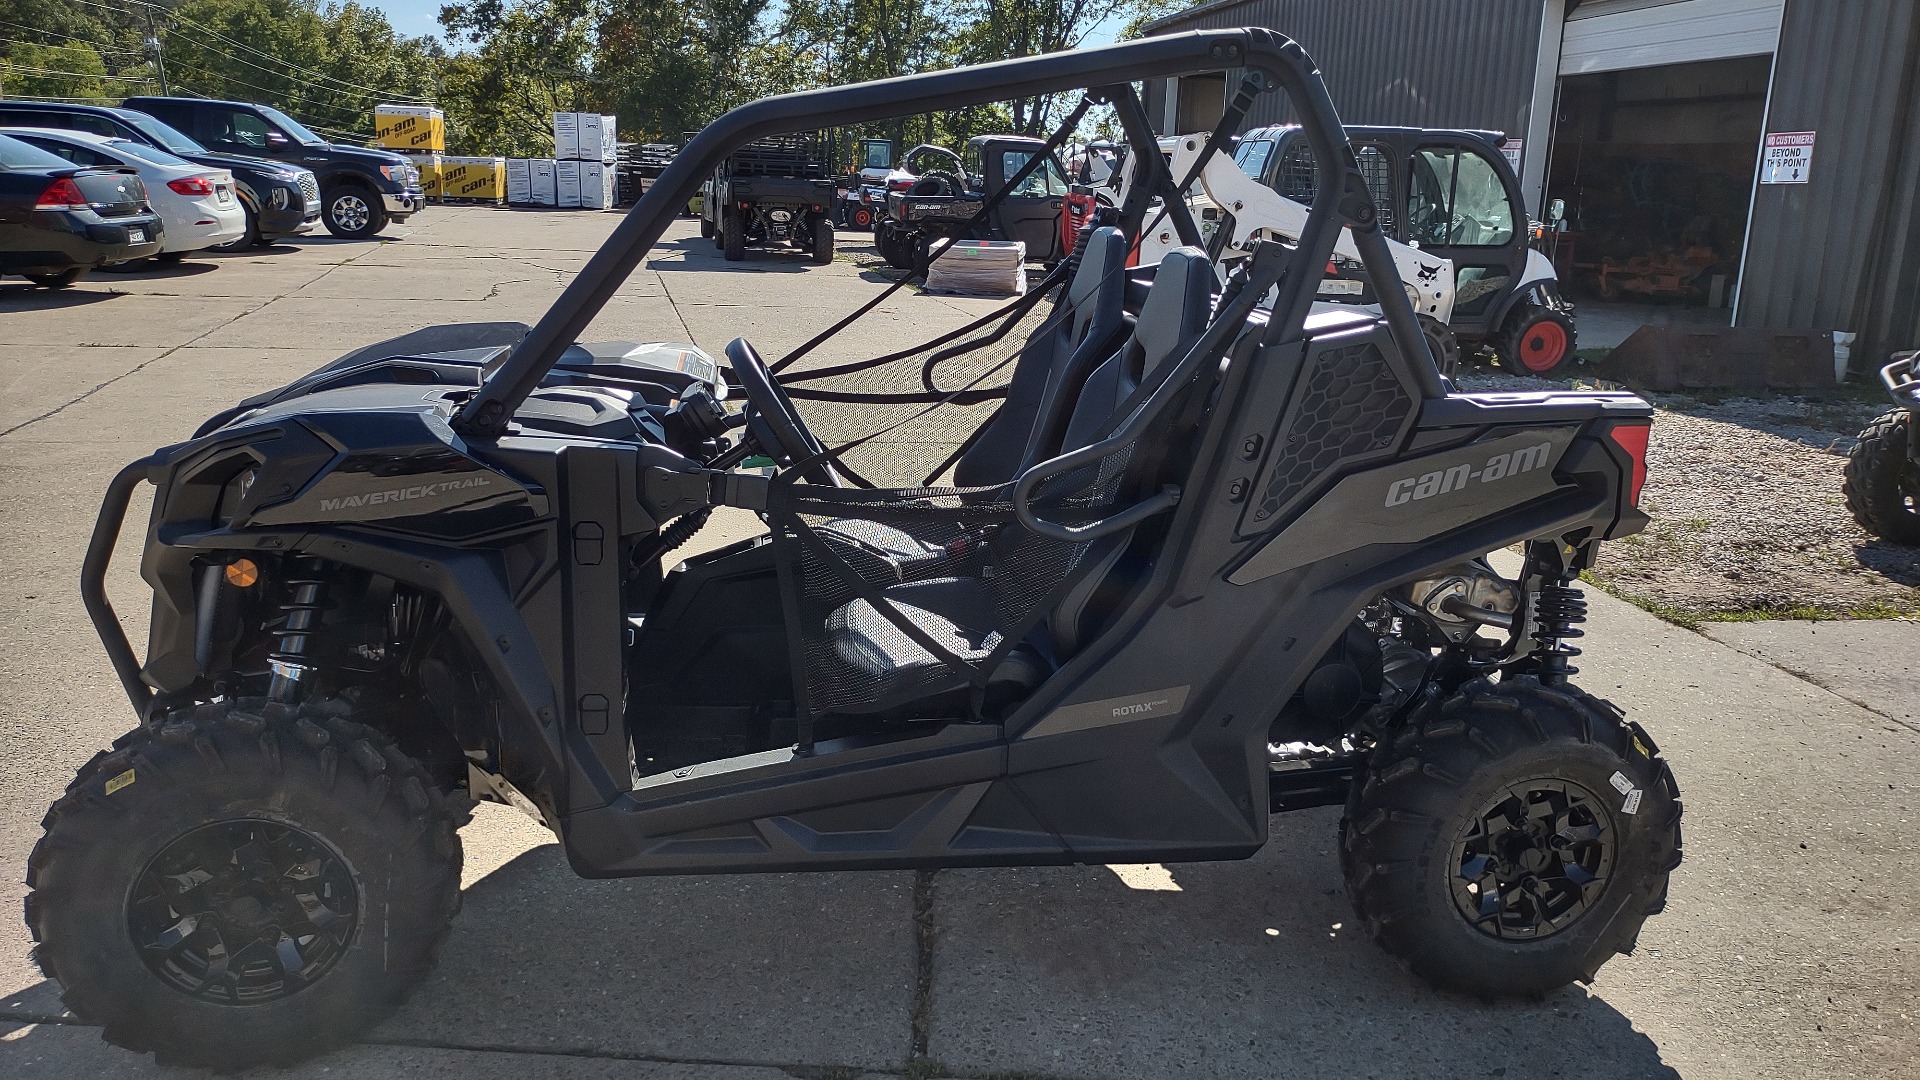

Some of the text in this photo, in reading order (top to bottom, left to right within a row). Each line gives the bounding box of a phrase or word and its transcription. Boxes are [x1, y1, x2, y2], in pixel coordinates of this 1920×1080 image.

[1776, 135, 1813, 145] CUSTOMERS
[1772, 148, 1801, 157] BEYOND
[1767, 158, 1807, 168] THS POINT
[1384, 441, 1551, 508] can-am
[319, 477, 491, 512] MAVERICK TRAIL
[1112, 701, 1152, 717] ROTAX
